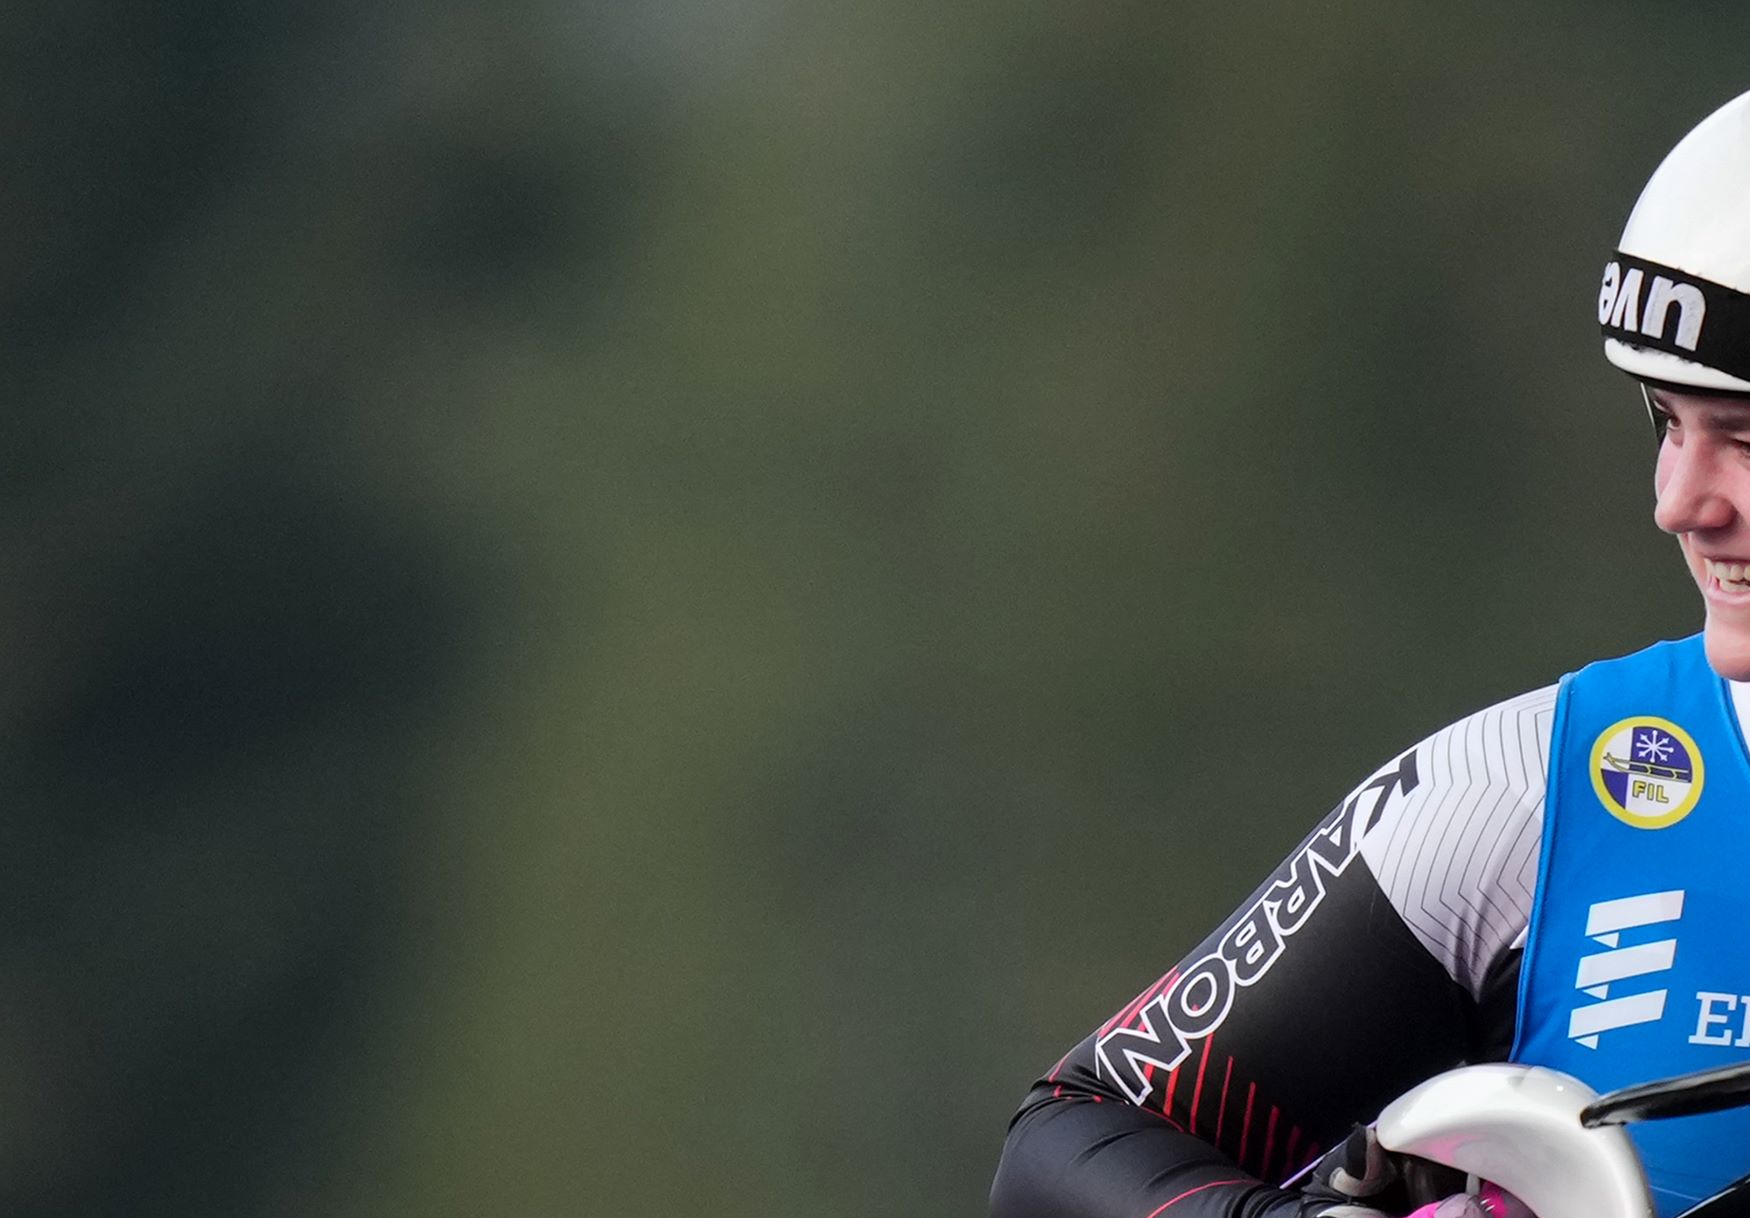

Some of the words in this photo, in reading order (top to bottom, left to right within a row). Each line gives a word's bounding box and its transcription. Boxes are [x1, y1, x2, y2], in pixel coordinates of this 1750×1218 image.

[1598, 262, 1706, 352] uve
[1632, 780, 1669, 804] FIL
[1097, 748, 1420, 1106] KARBON
